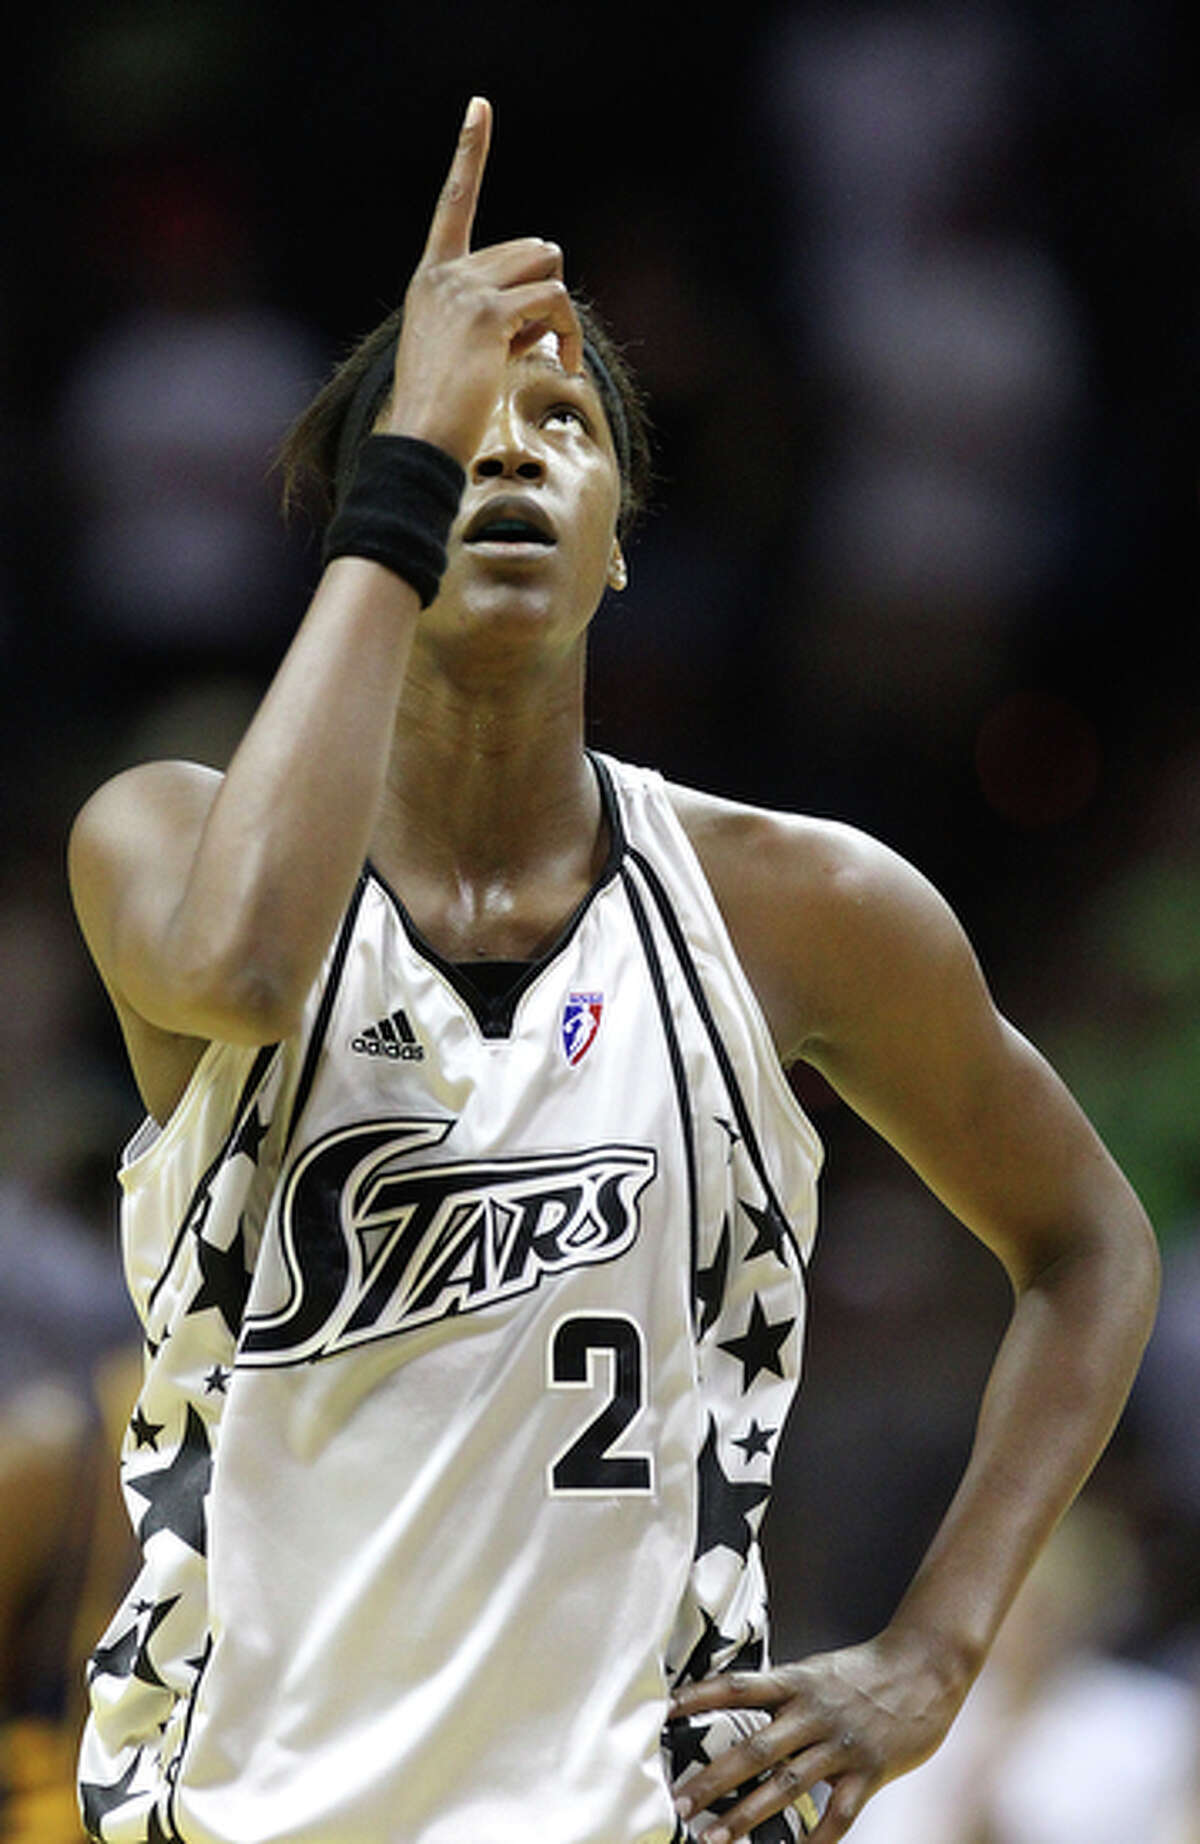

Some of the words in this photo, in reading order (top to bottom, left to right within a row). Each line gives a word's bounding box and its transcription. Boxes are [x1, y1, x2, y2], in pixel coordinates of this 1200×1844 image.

[351, 1038, 424, 1061] adidas
[236, 1118, 657, 1366] STARS
[548, 1311, 654, 1495] 2
